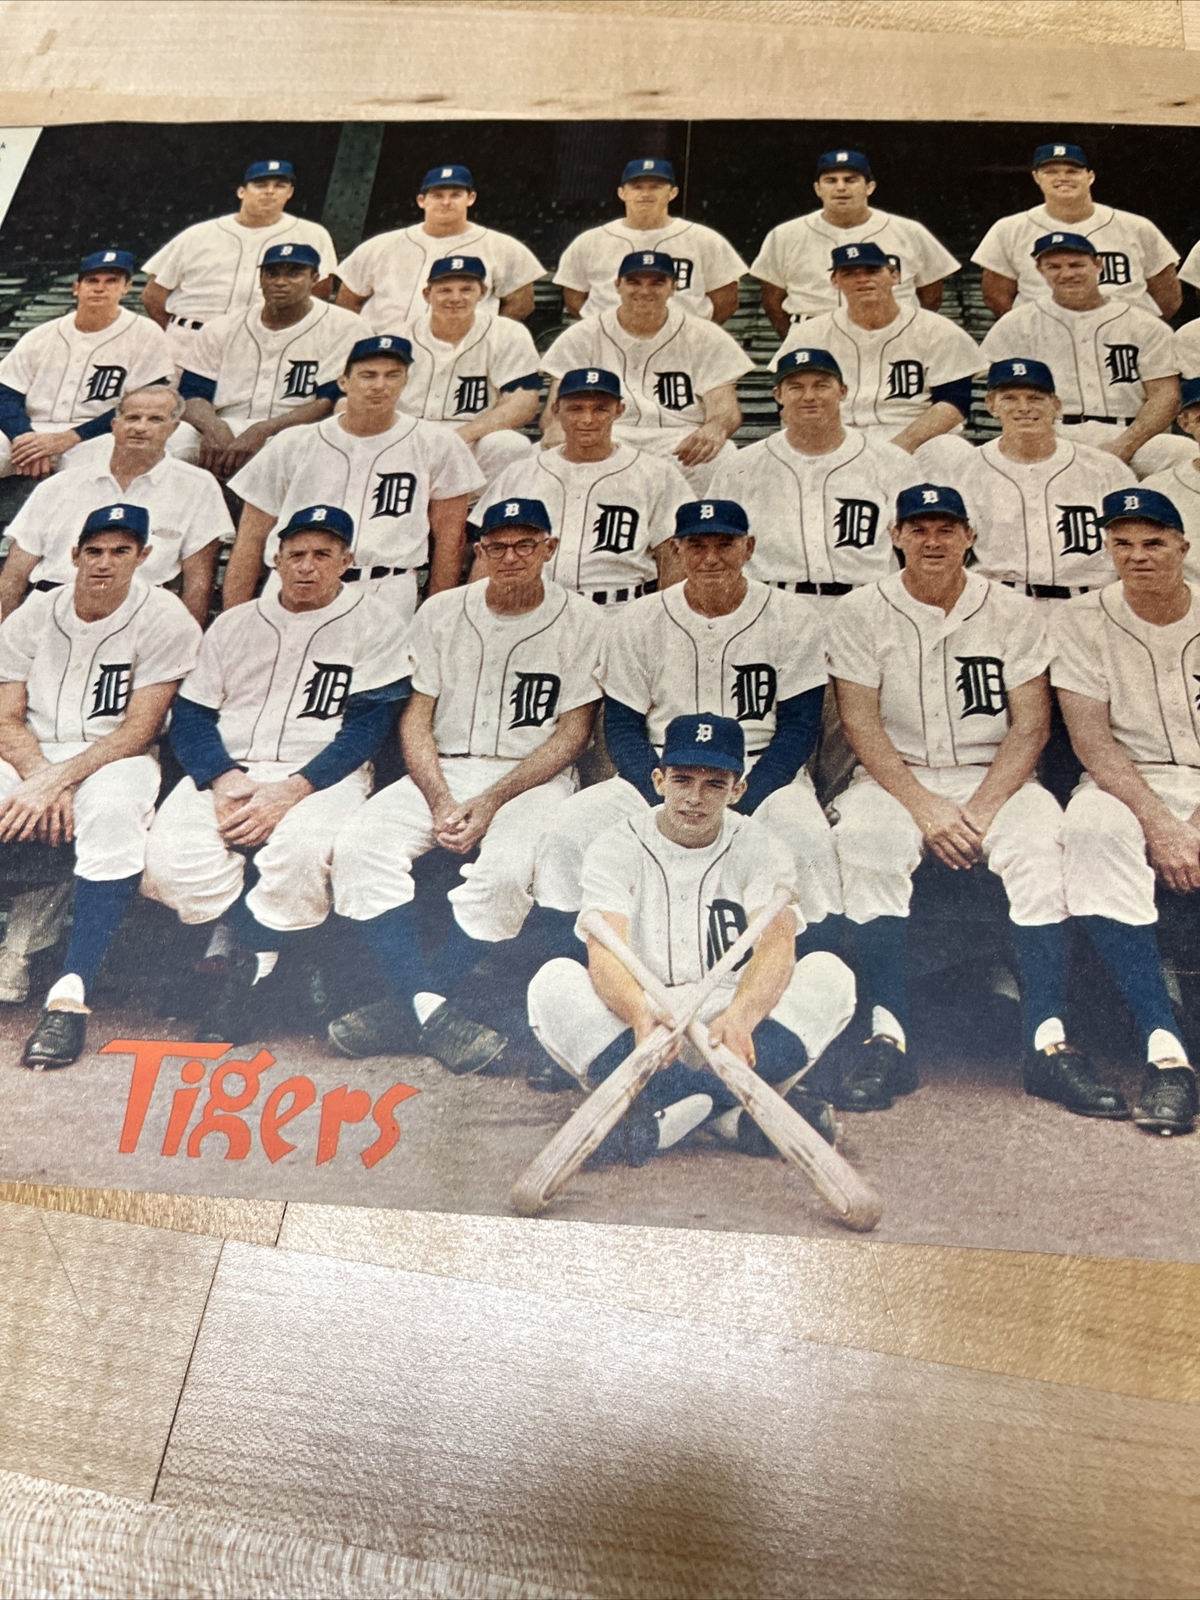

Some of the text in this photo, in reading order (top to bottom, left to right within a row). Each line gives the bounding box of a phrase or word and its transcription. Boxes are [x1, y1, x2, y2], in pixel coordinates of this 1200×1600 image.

[1098, 251, 1131, 285] D
[82, 364, 128, 403] D
[280, 359, 319, 400] D
[886, 359, 925, 400] D
[1104, 343, 1140, 386] D
[453, 375, 489, 416] D
[652, 371, 695, 411] D
[370, 472, 417, 519] D
[590, 503, 639, 554] D
[833, 497, 880, 549] D
[1055, 504, 1103, 556] D
[87, 663, 132, 720] D
[296, 660, 353, 721] D
[508, 671, 561, 730] D
[730, 663, 777, 722] D
[954, 655, 1008, 720] D
[706, 898, 755, 972] D
[97, 1039, 421, 1169] Tigers
